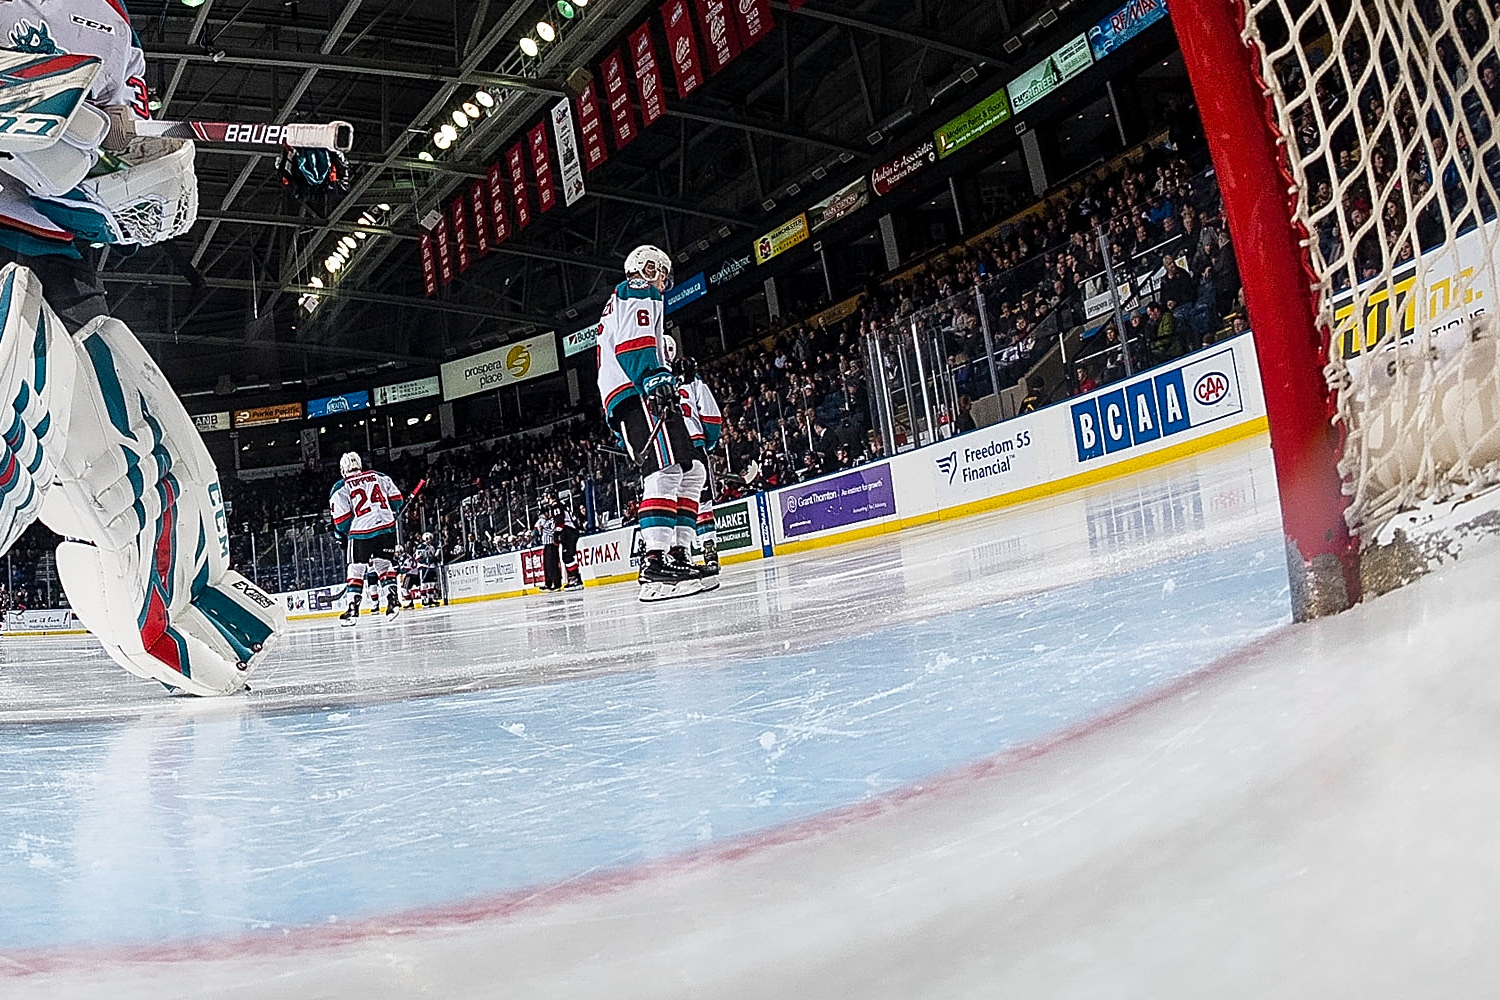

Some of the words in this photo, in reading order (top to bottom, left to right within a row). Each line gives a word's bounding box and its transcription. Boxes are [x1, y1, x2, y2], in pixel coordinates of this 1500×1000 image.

[71, 15, 114, 34] CCM
[1012, 71, 1059, 108] EVERGREEN
[945, 122, 968, 138] Modern
[987, 101, 1005, 116] Floors
[900, 141, 934, 169] Associates
[886, 167, 907, 185] Notaries
[906, 159, 924, 175] Public
[770, 218, 803, 240] MANCHESTER
[636, 309, 650, 327] 6
[576, 326, 601, 344] Budge
[464, 360, 502, 380] prospera
[479, 372, 503, 388] place
[1197, 378, 1226, 402] CAA
[274, 405, 300, 415] Pacific
[963, 440, 1012, 464] Freedom
[1016, 430, 1032, 448] 55
[350, 483, 389, 518] 24
[797, 495, 813, 508] Grant
[812, 490, 838, 504] Thornton
[207, 481, 230, 560] CCM
[715, 510, 748, 529] MARKET
[576, 543, 621, 568] RE/MAX
